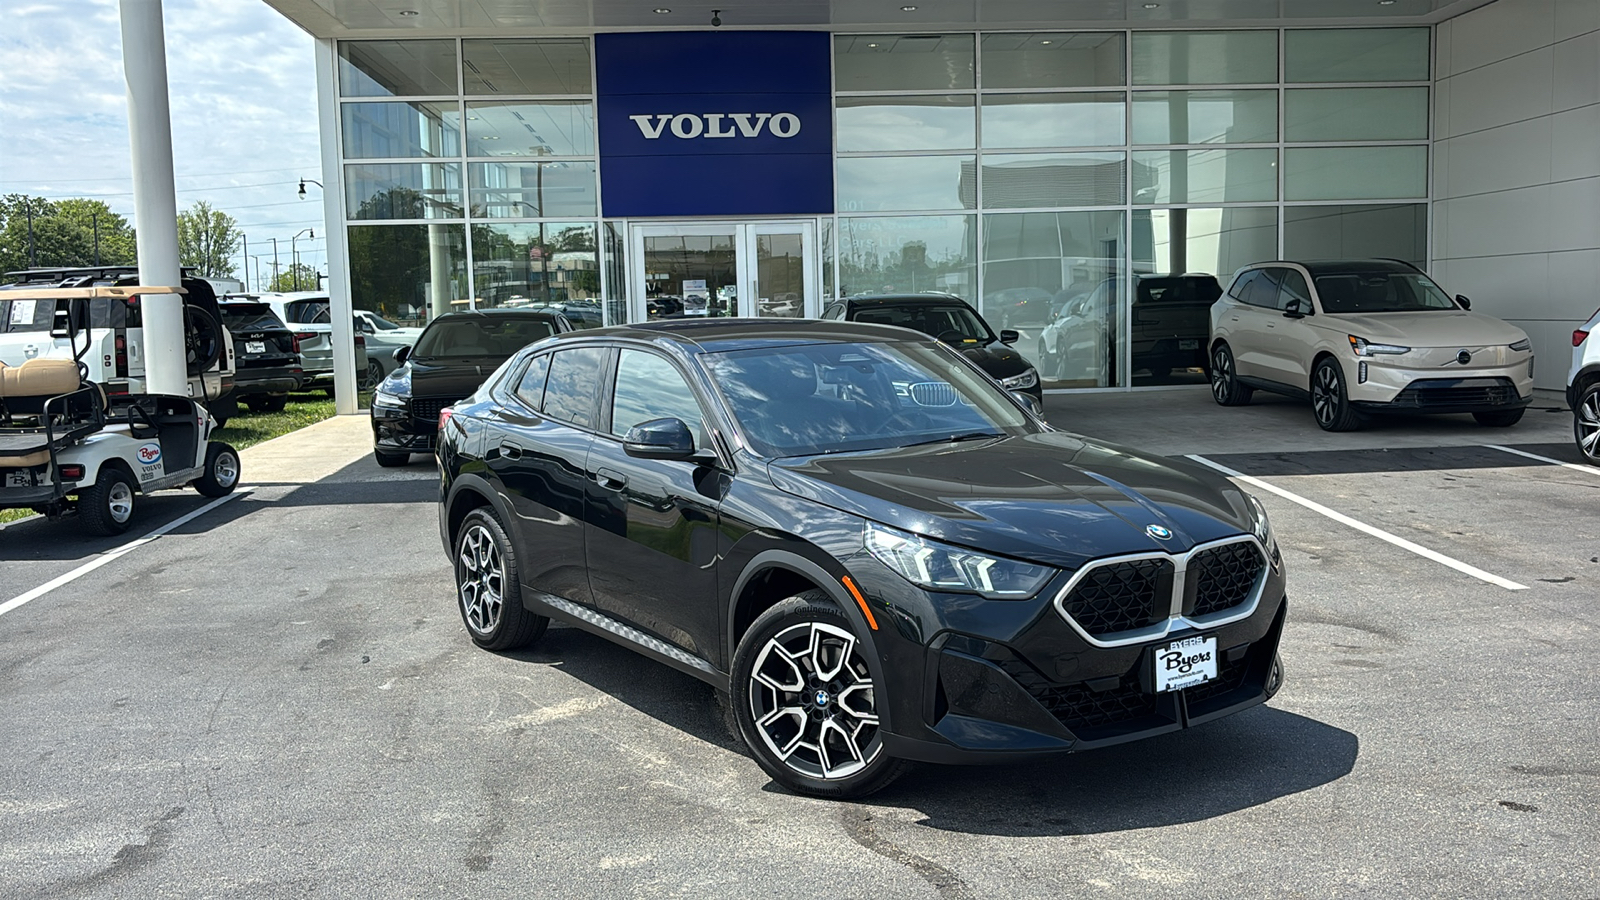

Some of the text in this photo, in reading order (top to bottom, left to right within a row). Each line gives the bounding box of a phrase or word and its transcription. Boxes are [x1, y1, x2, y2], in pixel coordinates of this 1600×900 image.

[629, 113, 801, 139] VOLVO
[139, 447, 159, 460] Byers
[141, 463, 162, 472] VOLVO
[1159, 651, 1211, 673] Byers
